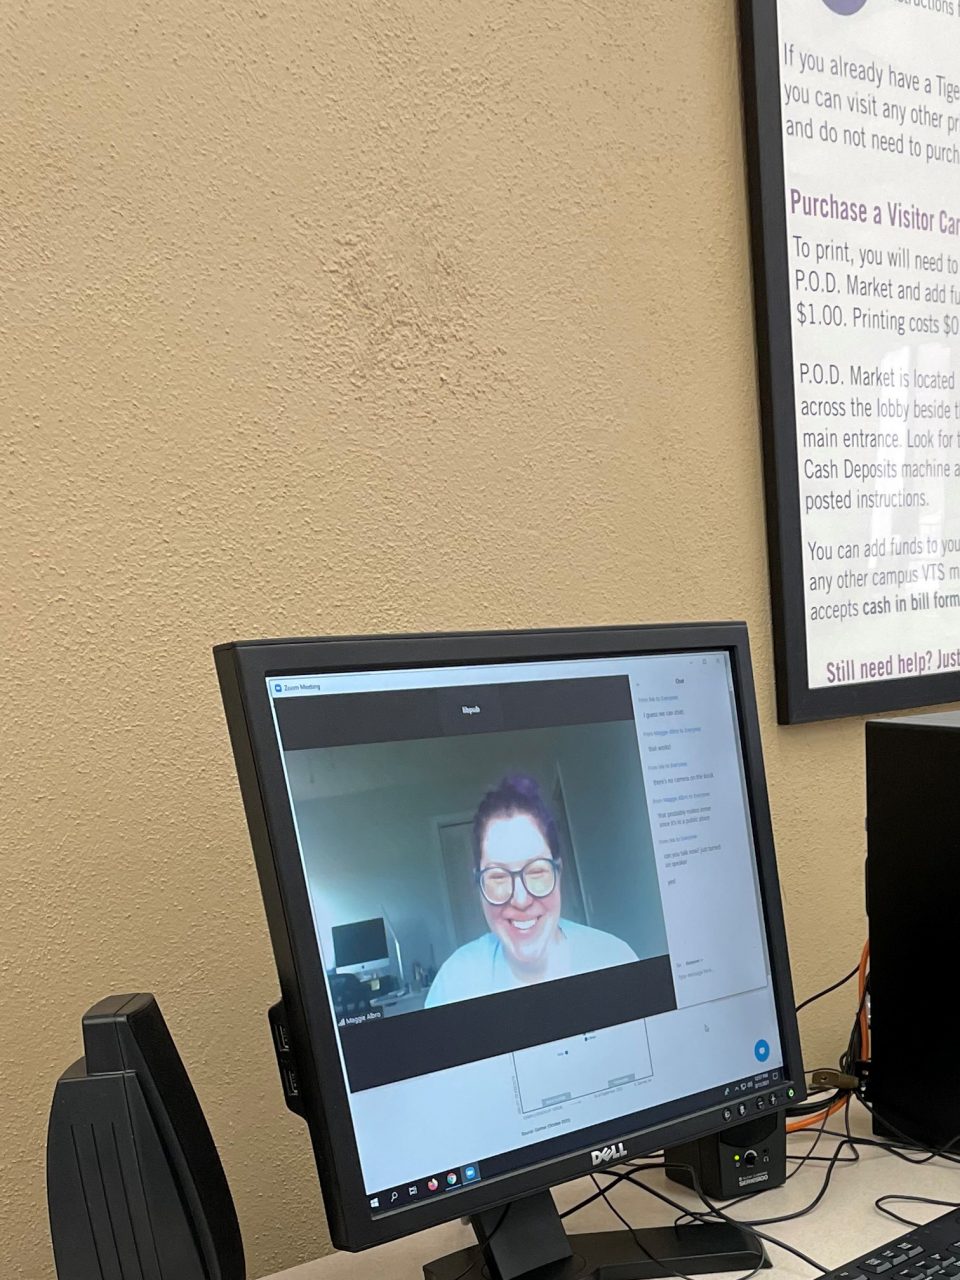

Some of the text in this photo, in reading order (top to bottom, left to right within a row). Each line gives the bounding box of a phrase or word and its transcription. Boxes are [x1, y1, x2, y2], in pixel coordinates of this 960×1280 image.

[784, 43, 794, 66] If
[799, 52, 824, 74] you
[830, 55, 883, 88] already
[889, 64, 920, 91] have
[924, 77, 932, 94] a
[784, 83, 809, 105] you
[815, 89, 842, 110] can
[847, 91, 878, 117] visit
[883, 102, 906, 126] any
[911, 104, 943, 129] other
[786, 118, 813, 139] and
[819, 120, 838, 143] do
[843, 127, 866, 148] not
[871, 131, 904, 154] need
[909, 135, 922, 158] to
[790, 188, 867, 223] Purchase
[873, 205, 882, 225] a
[887, 201, 934, 232] Visitor
[792, 235, 810, 258] To
[816, 239, 854, 266] print,
[859, 248, 883, 268] you
[887, 247, 910, 269] will
[915, 253, 943, 273] need
[947, 255, 958, 275] to
[795, 269, 841, 294] P.O.D.
[847, 274, 893, 299] Market
[898, 281, 921, 302] and
[925, 283, 946, 304] add
[796, 300, 847, 327] $1.00.
[853, 307, 905, 336] Printing
[909, 314, 940, 334] costs
[800, 363, 955, 390] P.O.D. Market is located
[801, 399, 846, 417] across
[851, 397, 872, 417] the
[877, 398, 909, 422] lobby
[914, 399, 951, 420] beside
[803, 427, 838, 448] main
[843, 429, 902, 448] entrance.
[907, 429, 934, 449] Look
[938, 429, 953, 449] for
[804, 459, 838, 479] Cash
[844, 459, 897, 483] Deposits
[901, 459, 950, 478] machine
[805, 489, 929, 515] posted instructions.
[808, 541, 832, 561] You
[838, 542, 860, 559] can
[864, 539, 886, 558] add
[891, 536, 923, 556] funds
[927, 536, 938, 554] to
[810, 575, 833, 595] any
[837, 569, 868, 589] other
[872, 568, 919, 589] campus
[922, 563, 945, 582] VTS
[810, 600, 859, 622] accepts
[863, 595, 891, 616] cash
[896, 593, 907, 612] in
[911, 592, 929, 611] bill
[933, 591, 960, 609] form
[826, 659, 855, 684] Still
[860, 655, 892, 679] need
[898, 650, 933, 675] help?
[937, 647, 960, 670] Just
[590, 1142, 628, 1166] DELL
